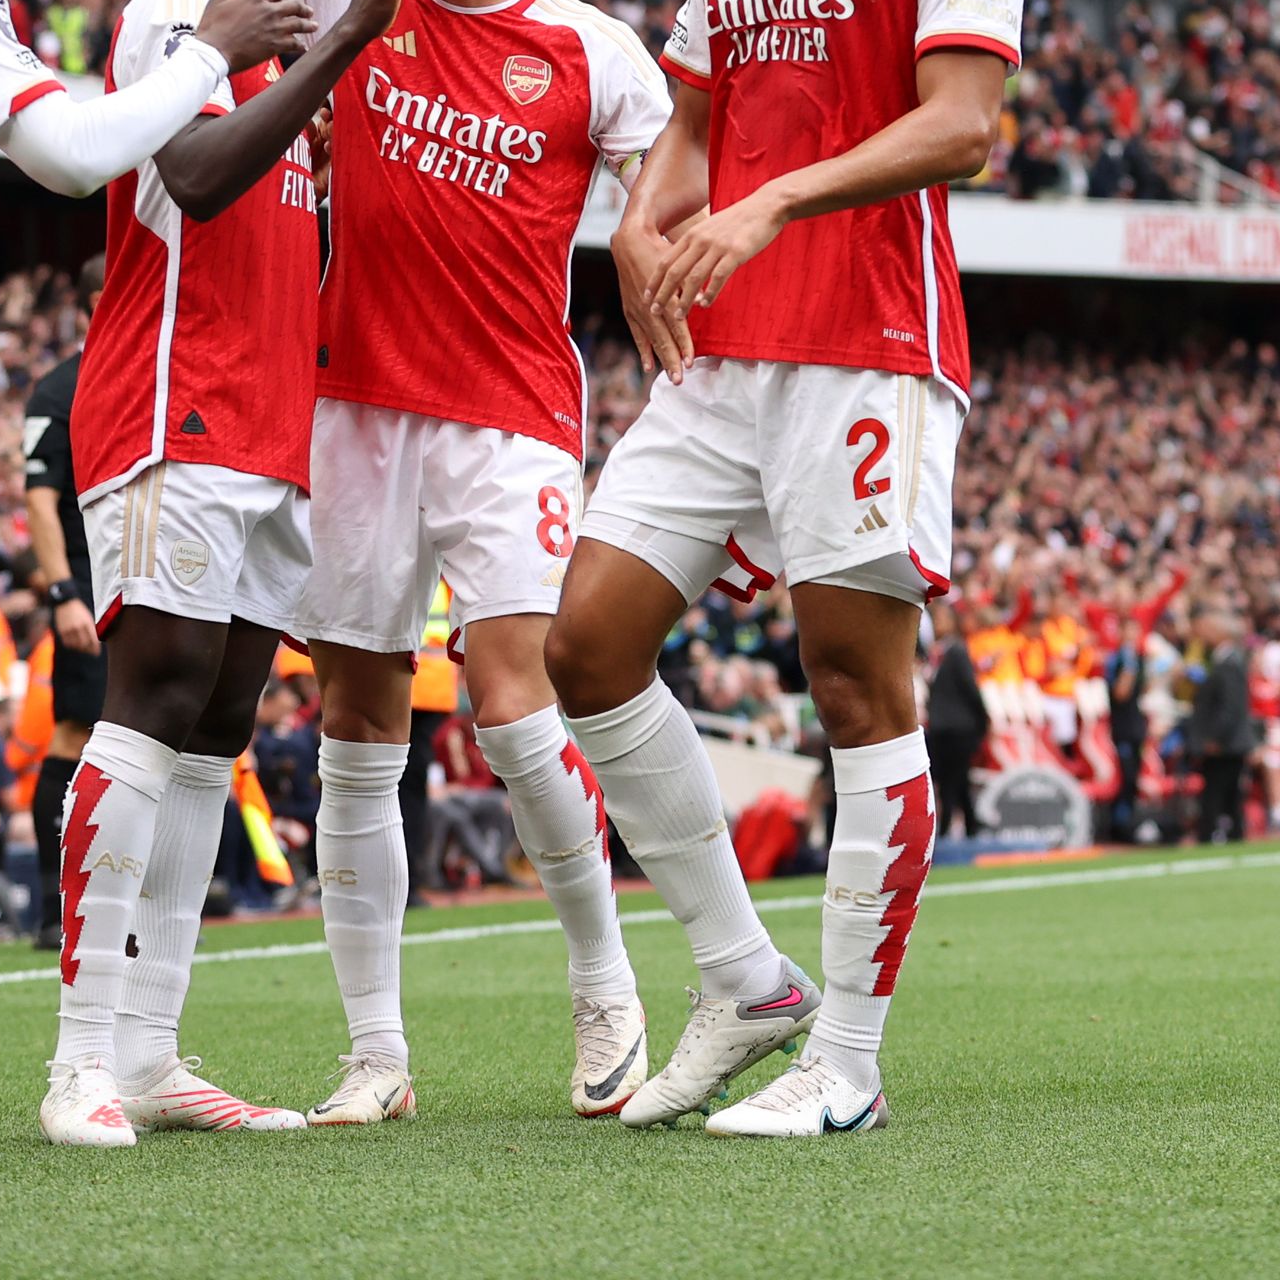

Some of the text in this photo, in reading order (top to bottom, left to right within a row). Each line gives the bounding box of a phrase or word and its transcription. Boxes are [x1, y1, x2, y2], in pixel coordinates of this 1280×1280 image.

[511, 62, 546, 77] Arsenal
[756, 25, 830, 62] BETTER
[365, 65, 548, 164] Emirates
[281, 169, 305, 209] FLY
[379, 124, 510, 198] FLY BETTER
[846, 417, 891, 501] 2
[536, 485, 574, 559] 8
[313, 868, 359, 887] FC
